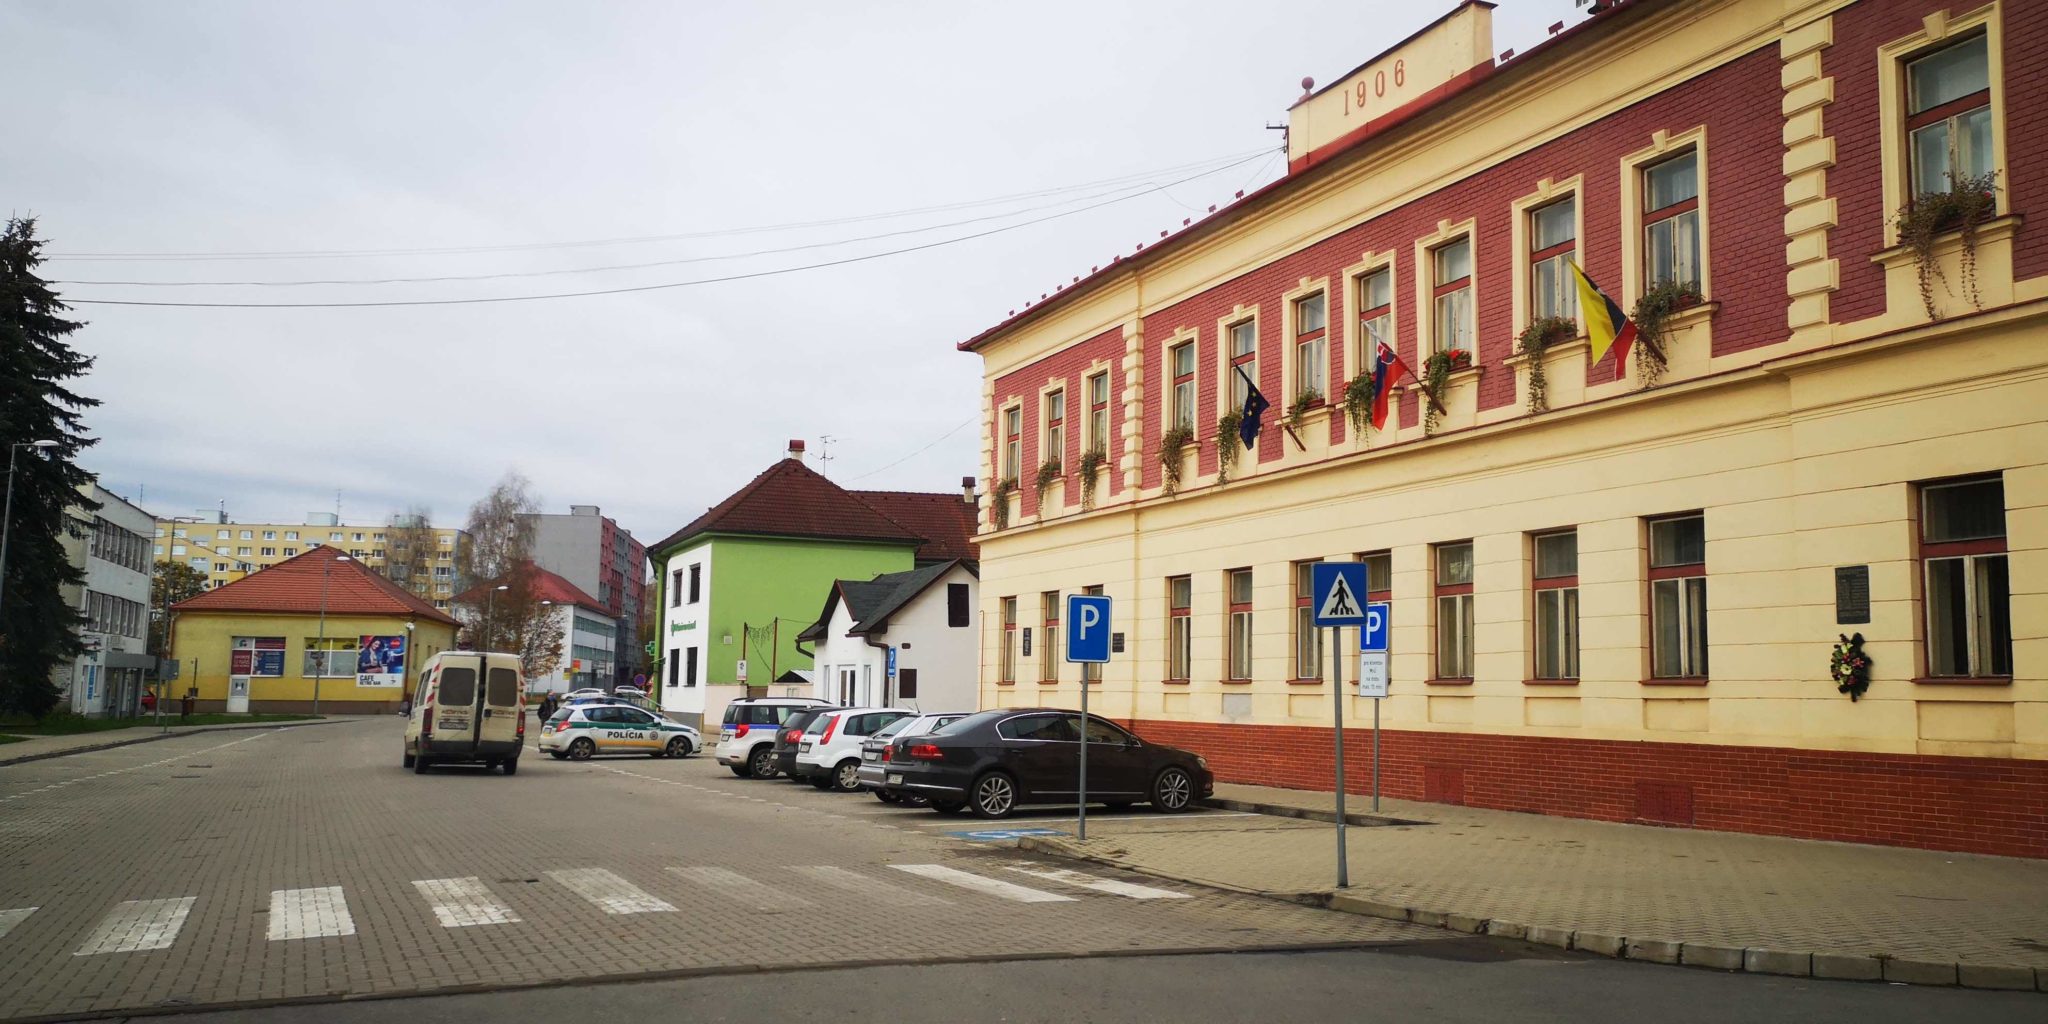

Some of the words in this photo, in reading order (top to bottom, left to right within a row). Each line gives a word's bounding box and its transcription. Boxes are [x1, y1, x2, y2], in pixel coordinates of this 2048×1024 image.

[1343, 58, 1405, 117] 1906
[1080, 604, 1100, 640] P
[1366, 611, 1381, 645] P
[607, 730, 644, 739] POLÍCIA
